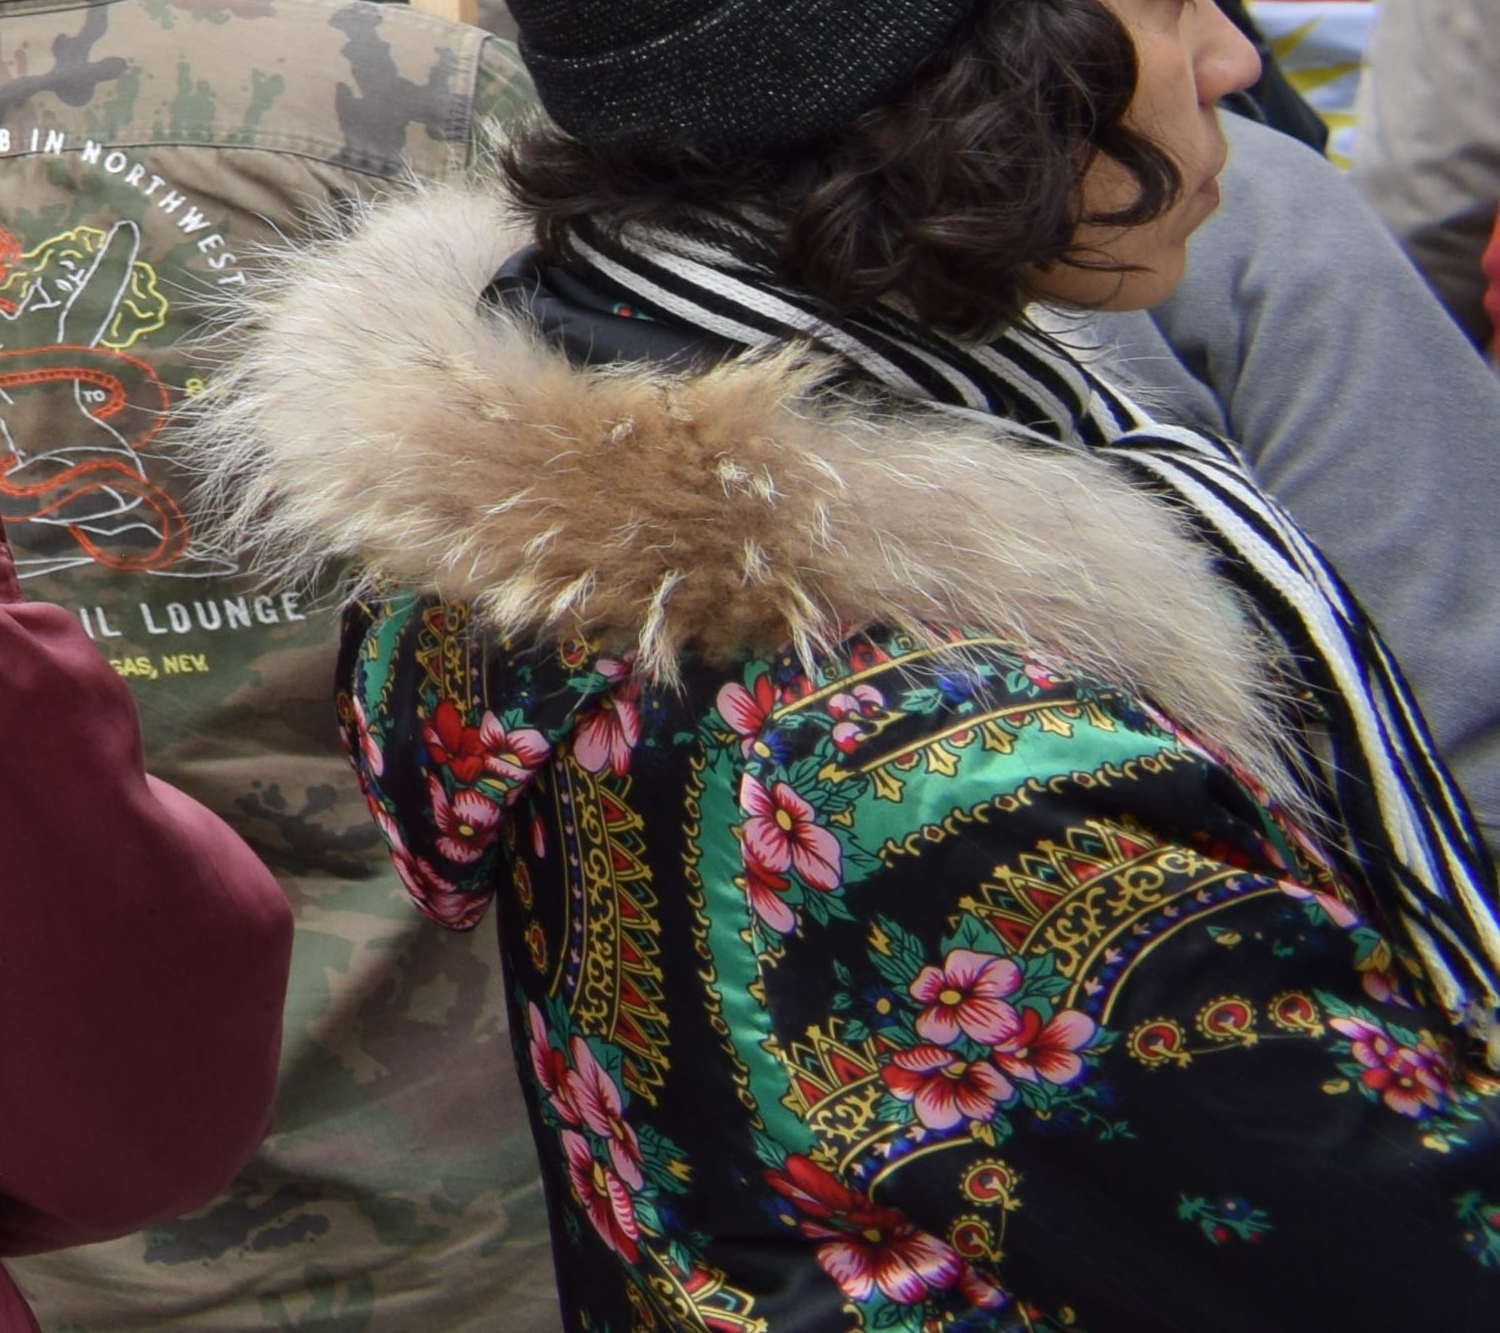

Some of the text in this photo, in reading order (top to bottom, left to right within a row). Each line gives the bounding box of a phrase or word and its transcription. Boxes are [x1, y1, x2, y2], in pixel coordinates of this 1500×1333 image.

[30, 127, 65, 155] IN
[80, 139, 247, 286] NORTHWEST
[82, 389, 106, 403] TO
[138, 591, 307, 635] LOUNGE
